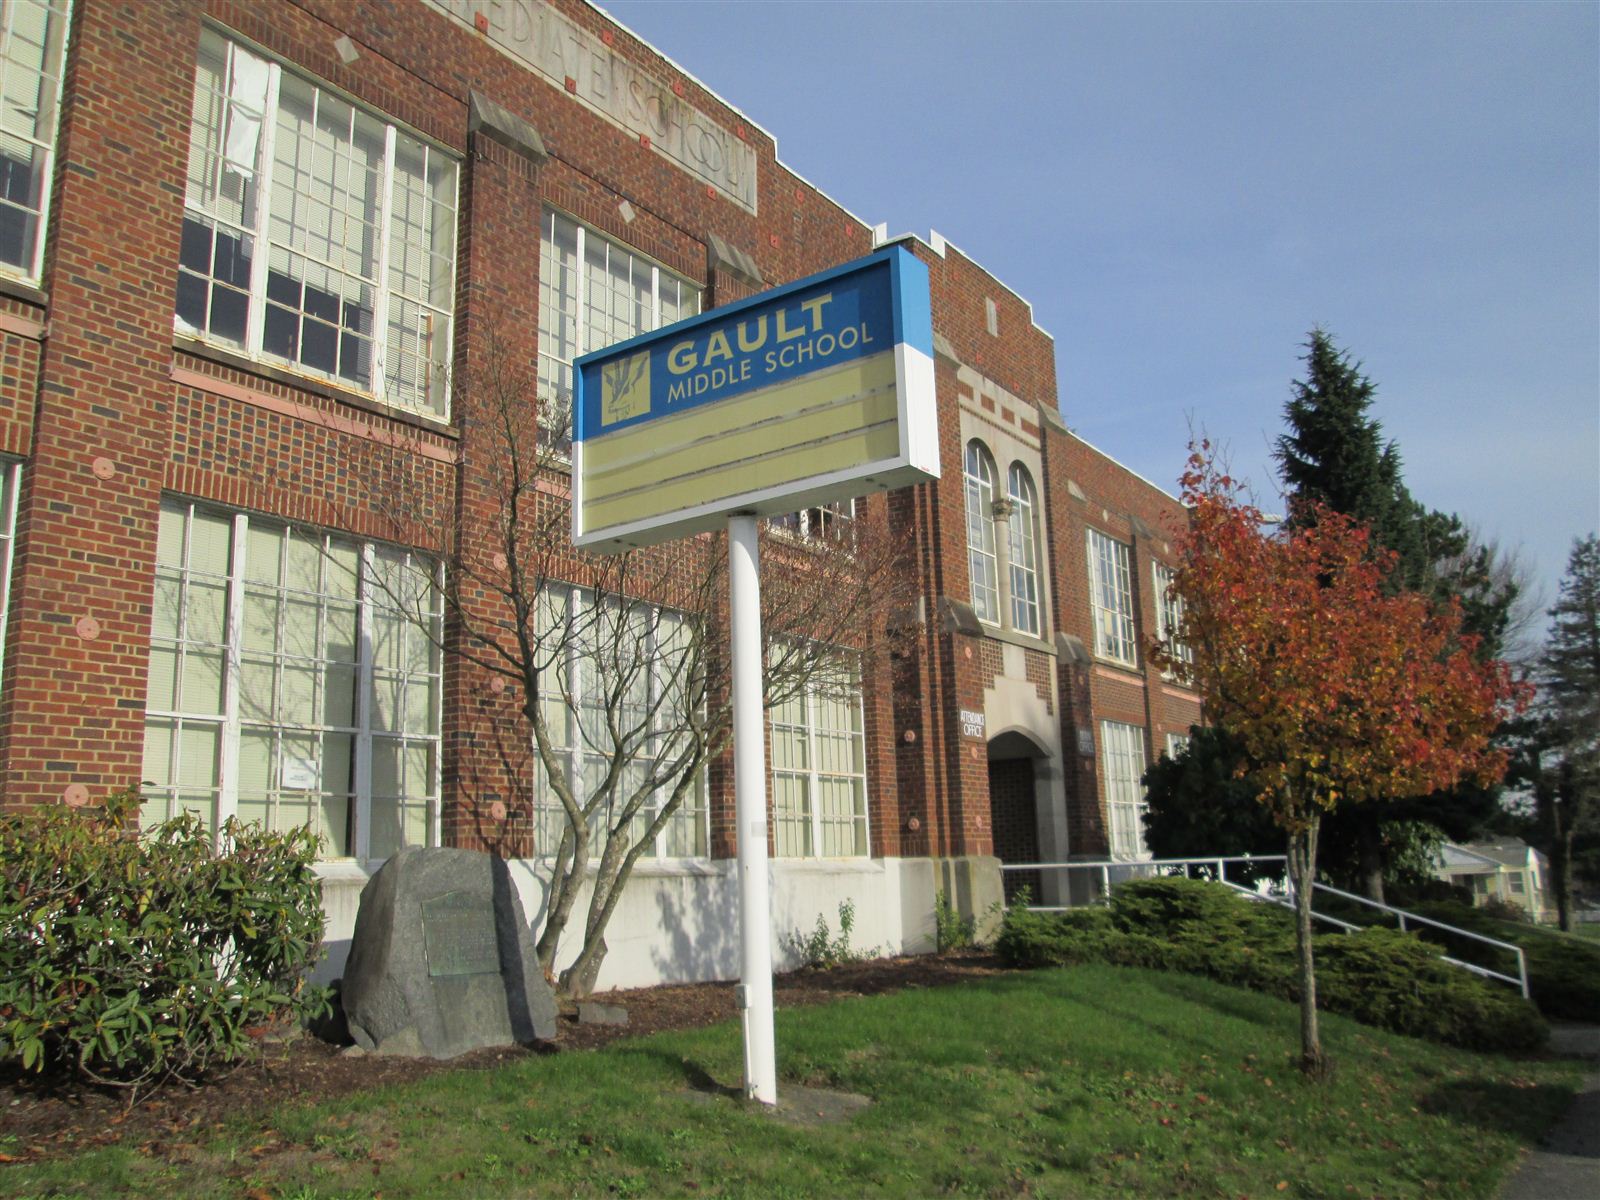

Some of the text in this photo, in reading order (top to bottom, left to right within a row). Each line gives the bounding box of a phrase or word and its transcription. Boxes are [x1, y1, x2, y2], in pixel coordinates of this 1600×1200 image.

[629, 81, 738, 186] SCHOOL
[667, 292, 832, 375] GAULT
[668, 322, 873, 404] MIDDLE SCHOOL
[963, 723, 983, 738] OFFICE
